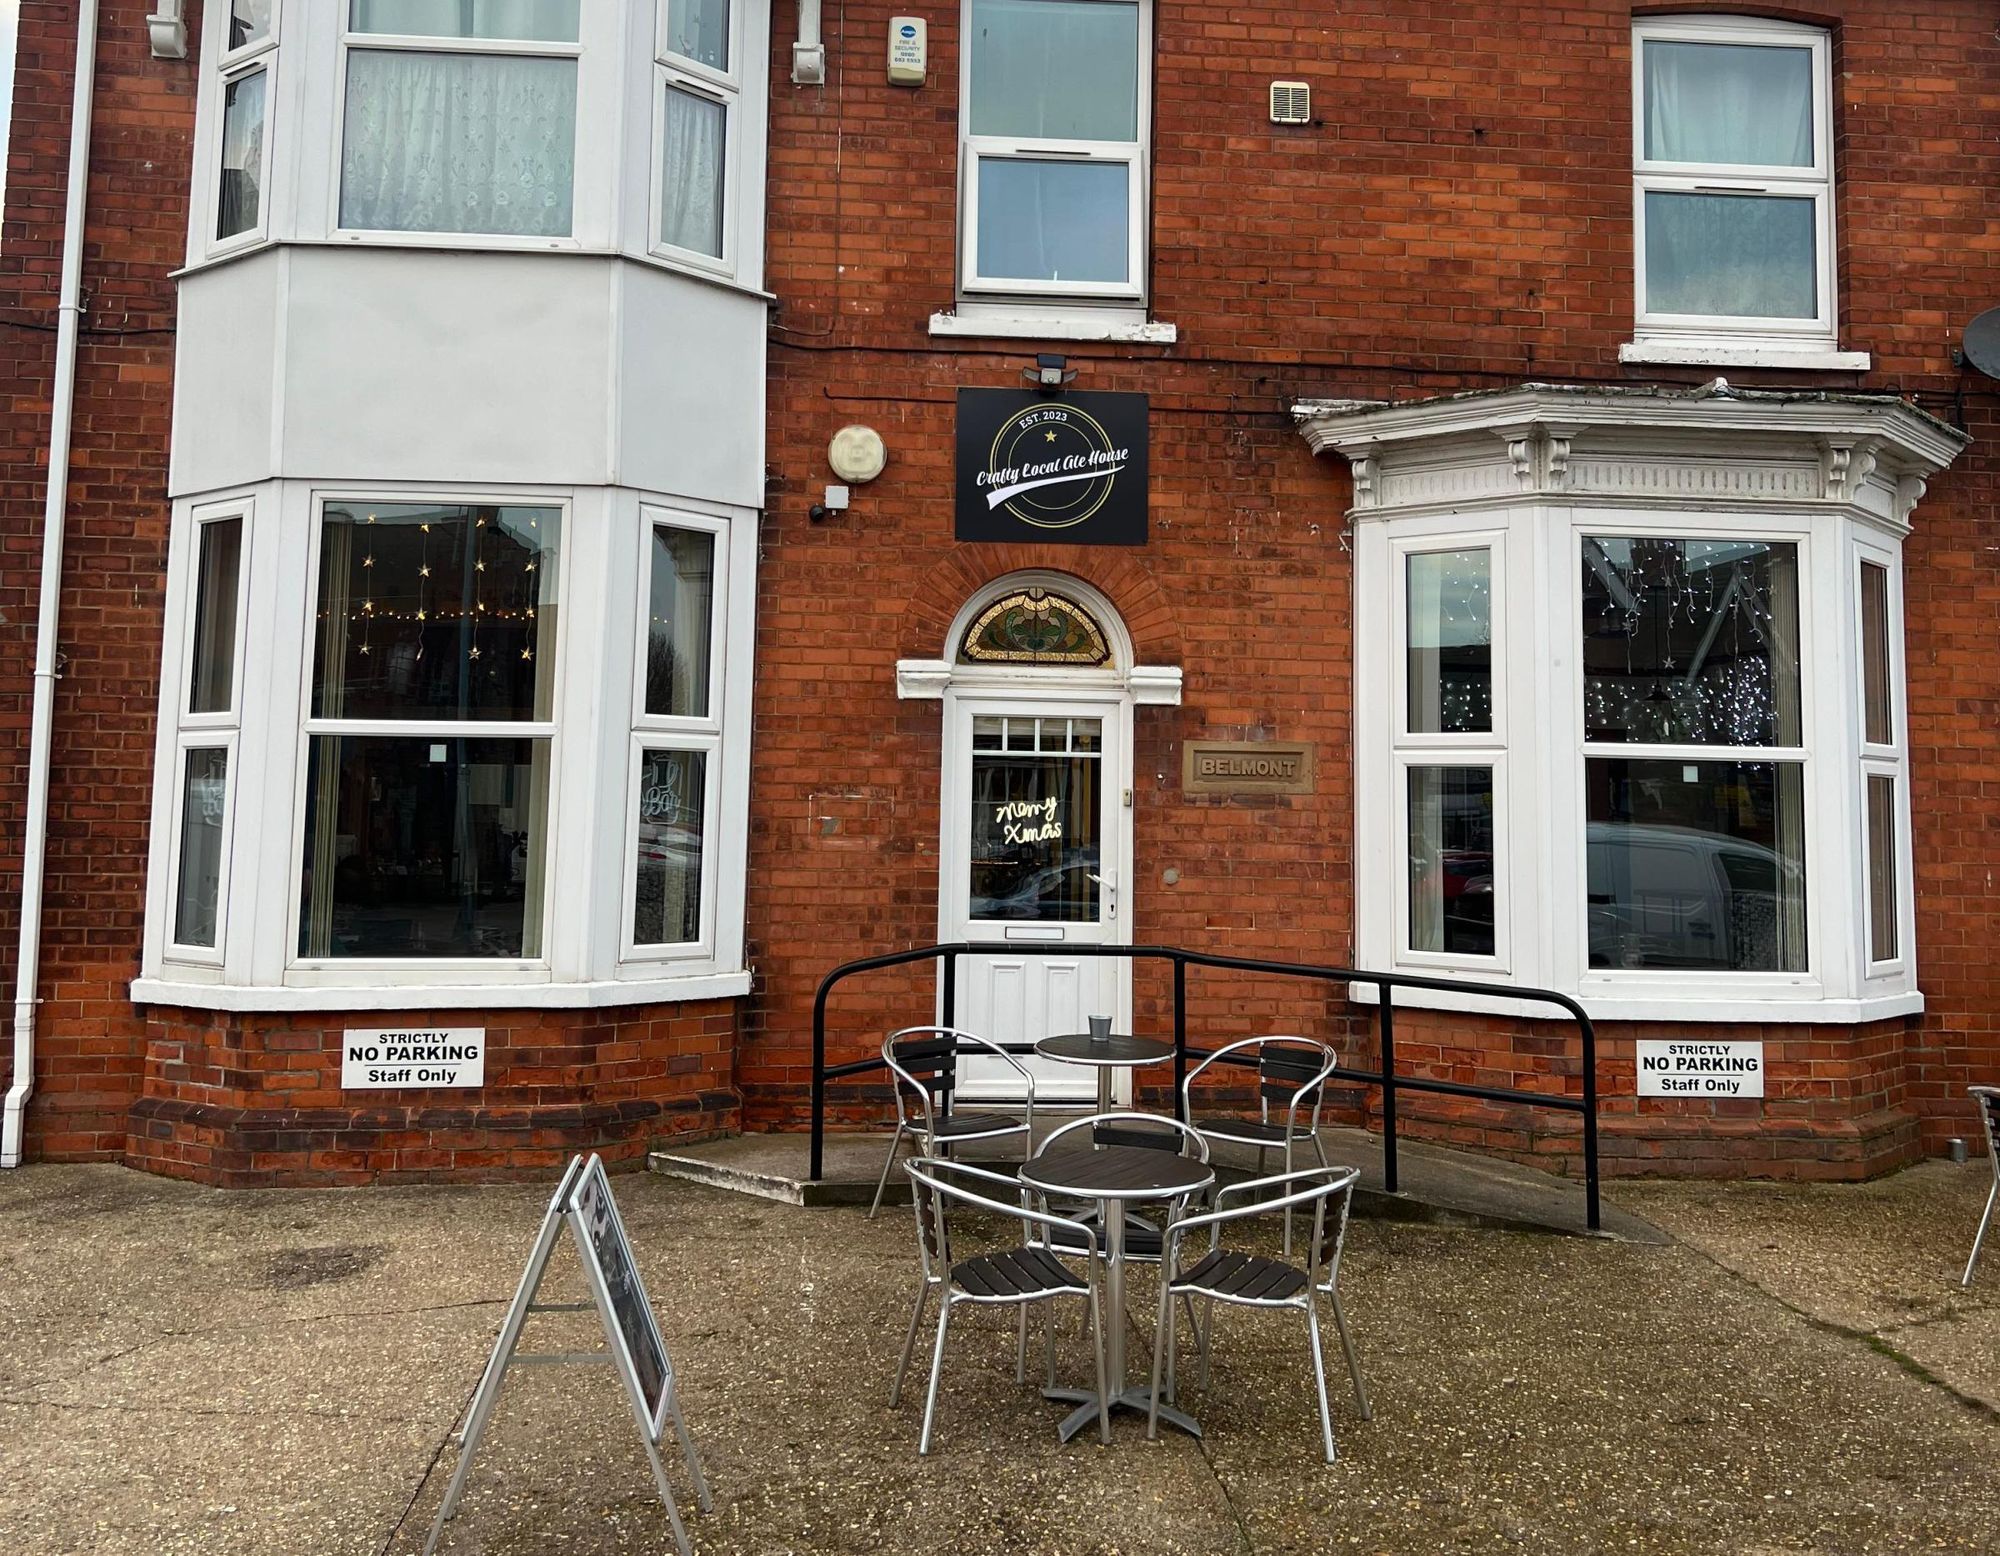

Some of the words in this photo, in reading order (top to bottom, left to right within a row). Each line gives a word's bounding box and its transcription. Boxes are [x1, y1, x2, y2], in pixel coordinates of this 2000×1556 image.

[1019, 412, 1042, 429] EST.
[1042, 411, 1068, 422] 2023
[976, 467, 1020, 486] Crafty
[1022, 458, 1061, 478] Local
[1062, 455, 1087, 471] Ale
[1088, 448, 1130, 467] House
[1200, 757, 1296, 777] BELMONT
[1003, 822, 1062, 845] Xmas
[379, 1033, 449, 1044] STRICTLY
[349, 1047, 379, 1061] NO
[386, 1045, 478, 1061] PARKING
[1668, 1045, 1730, 1055] STRICTLY
[1643, 1057, 1669, 1070] NO
[1676, 1057, 1758, 1071] PARKING
[368, 1069, 412, 1082] Staff
[417, 1069, 457, 1084] Only
[1661, 1079, 1700, 1091] Staff
[1705, 1079, 1740, 1094] Only
